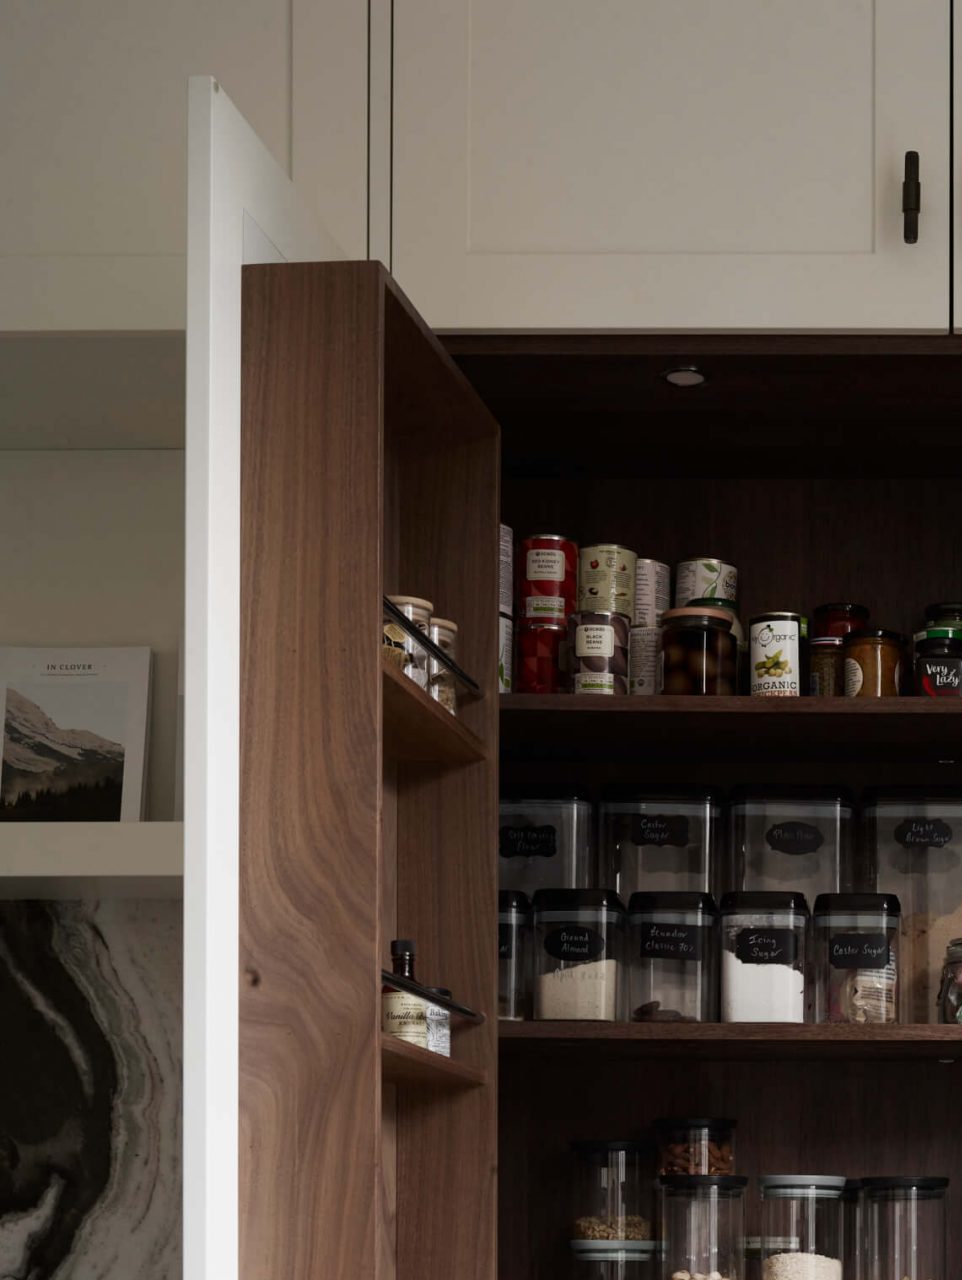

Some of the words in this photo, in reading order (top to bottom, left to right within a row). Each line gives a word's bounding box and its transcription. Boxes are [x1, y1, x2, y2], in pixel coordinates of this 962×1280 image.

[47, 663, 57, 671] IN
[59, 663, 93, 671] CLOVER
[926, 663, 948, 676] Very
[936, 669, 960, 687] Lazy
[752, 681, 798, 692] ORGANIC
[748, 934, 777, 949] Icing
[751, 947, 783, 960] Sugar
